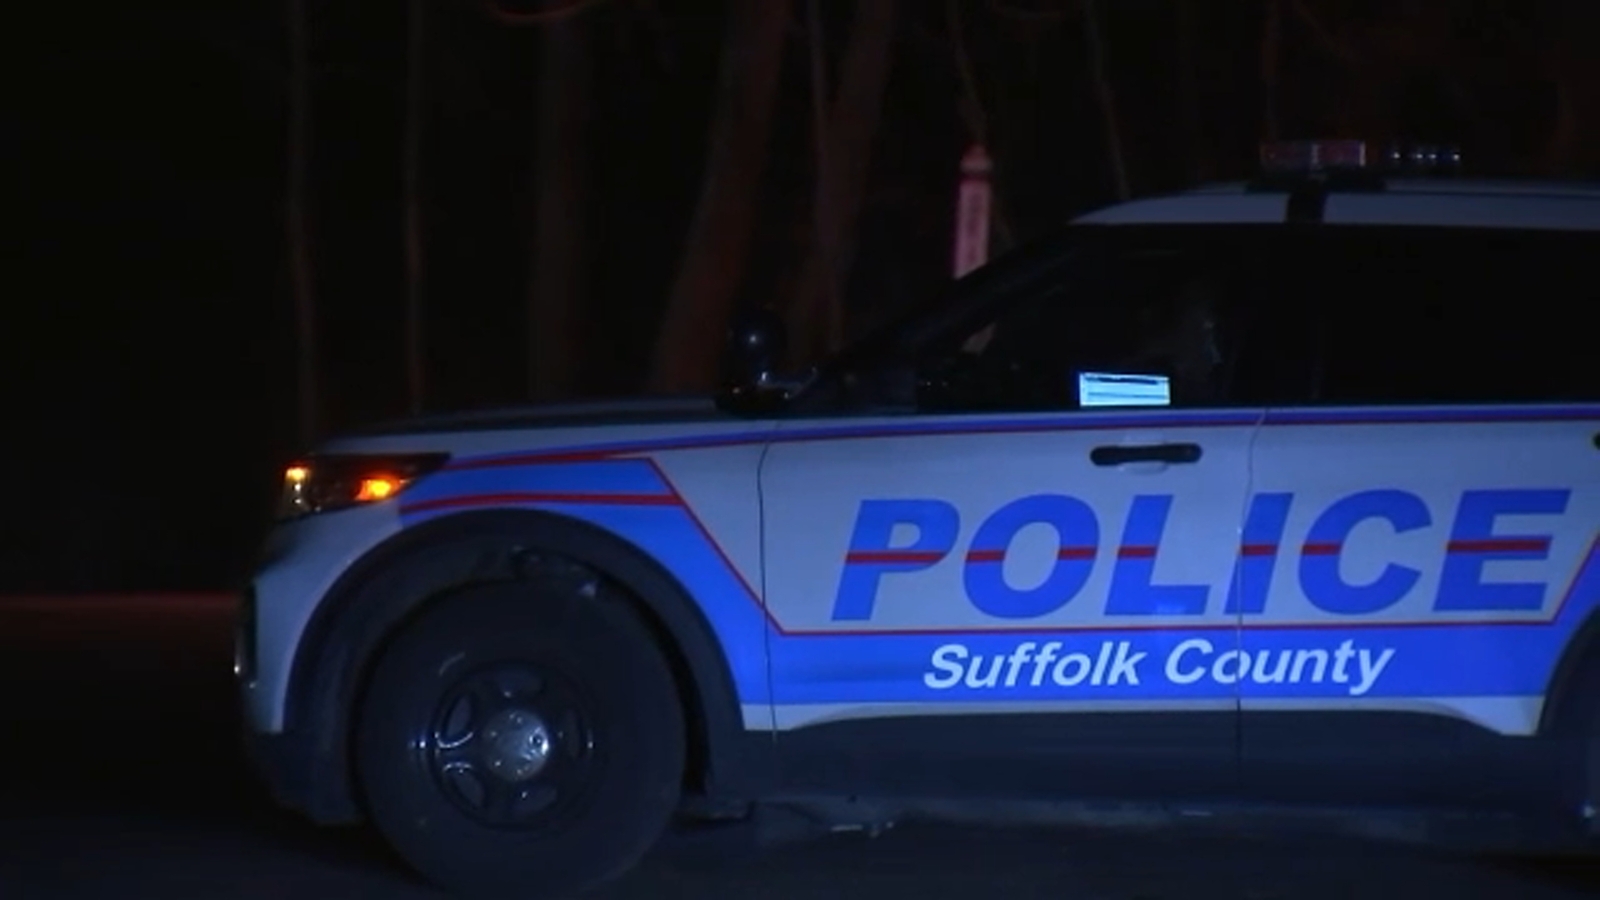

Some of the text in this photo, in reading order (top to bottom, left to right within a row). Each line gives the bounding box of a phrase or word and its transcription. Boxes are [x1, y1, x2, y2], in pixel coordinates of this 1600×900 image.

[832, 488, 1570, 620] POLICE
[923, 638, 1394, 695] Suffolk County
